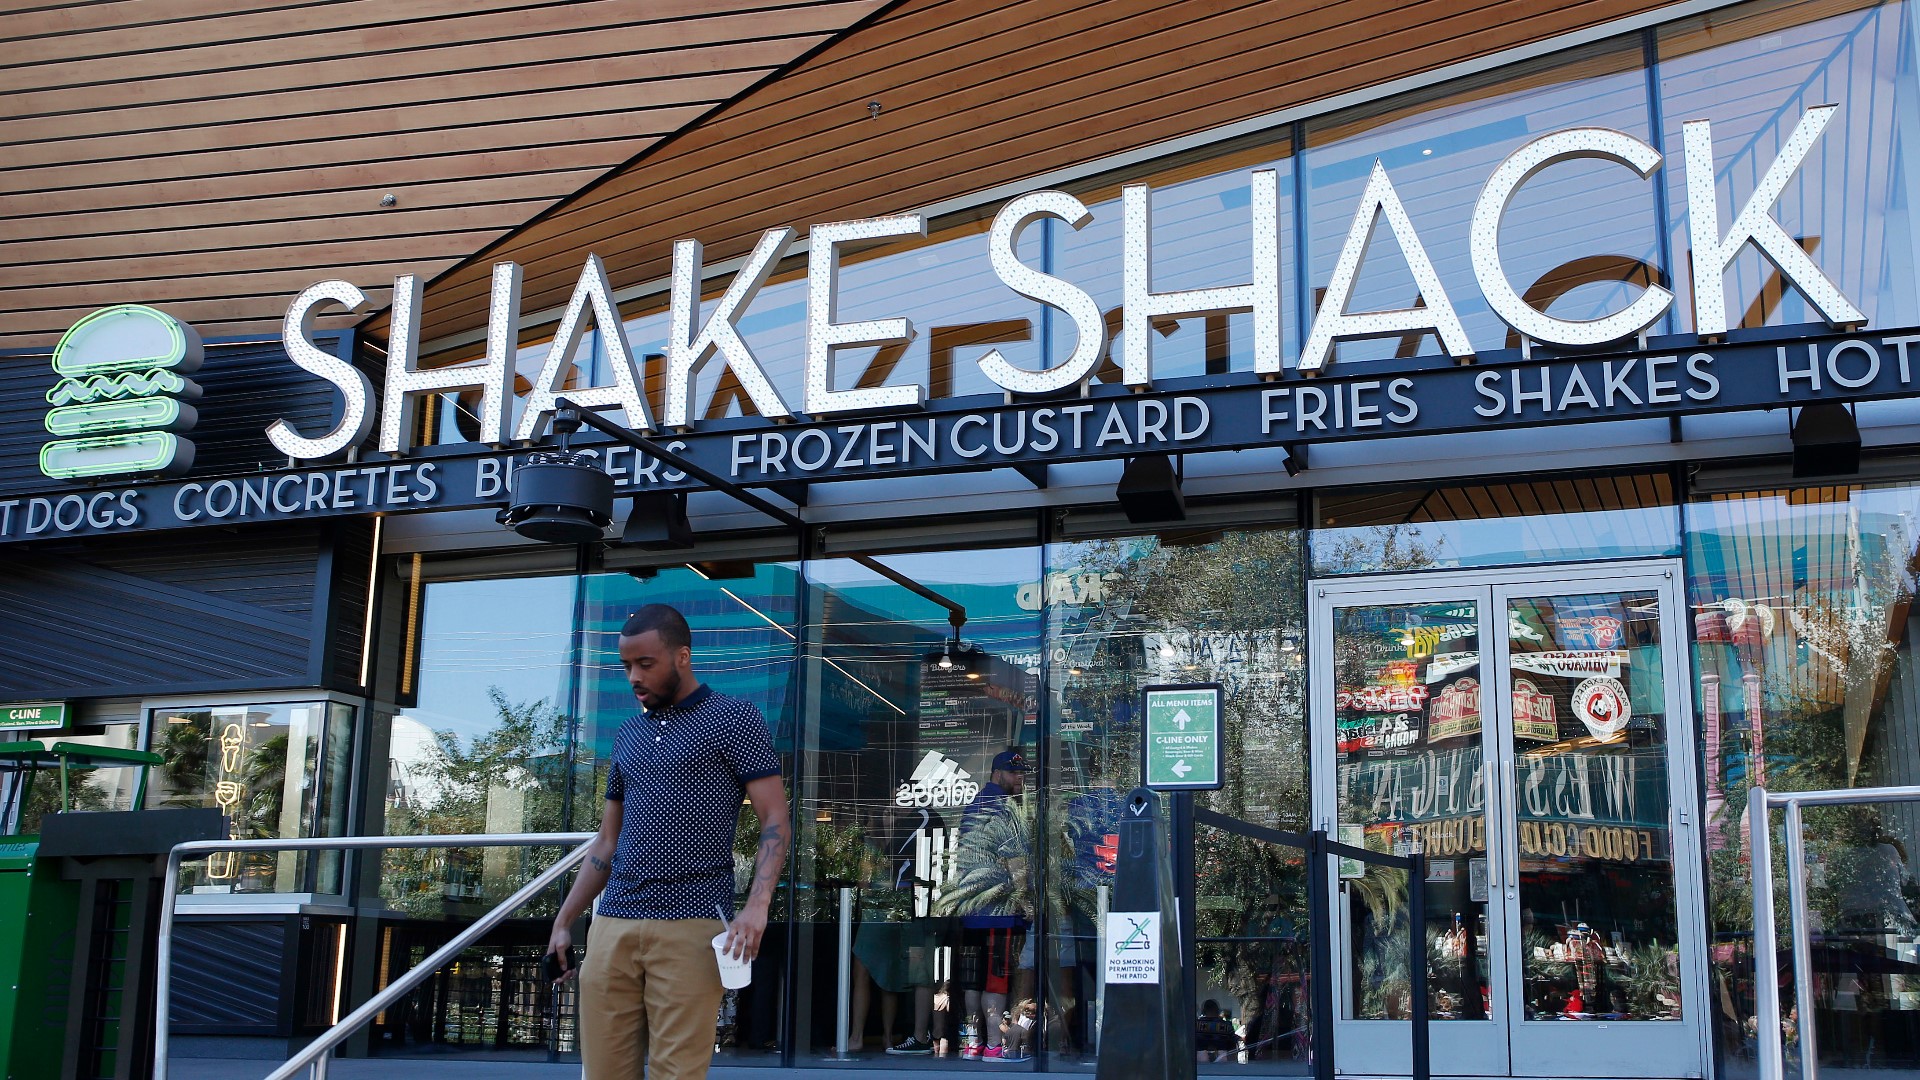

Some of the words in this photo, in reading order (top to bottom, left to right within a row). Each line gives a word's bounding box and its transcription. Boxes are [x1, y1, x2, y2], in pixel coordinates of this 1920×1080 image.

[265, 213, 928, 460] SHAKE
[976, 102, 1869, 395] SHACK
[25, 489, 139, 534] DOGS
[173, 462, 438, 521] CONCRETES
[475, 440, 687, 498] BERS
[731, 418, 935, 476] FROZEN
[950, 397, 1210, 459] CUSTARD
[1262, 378, 1418, 434] FRIES
[1473, 352, 1721, 418] SHAKES
[1776, 335, 1920, 393] HOT
[10, 708, 42, 720] C-LINE
[1156, 736, 1183, 744] C-LINE
[1184, 735, 1208, 743] ONLY
